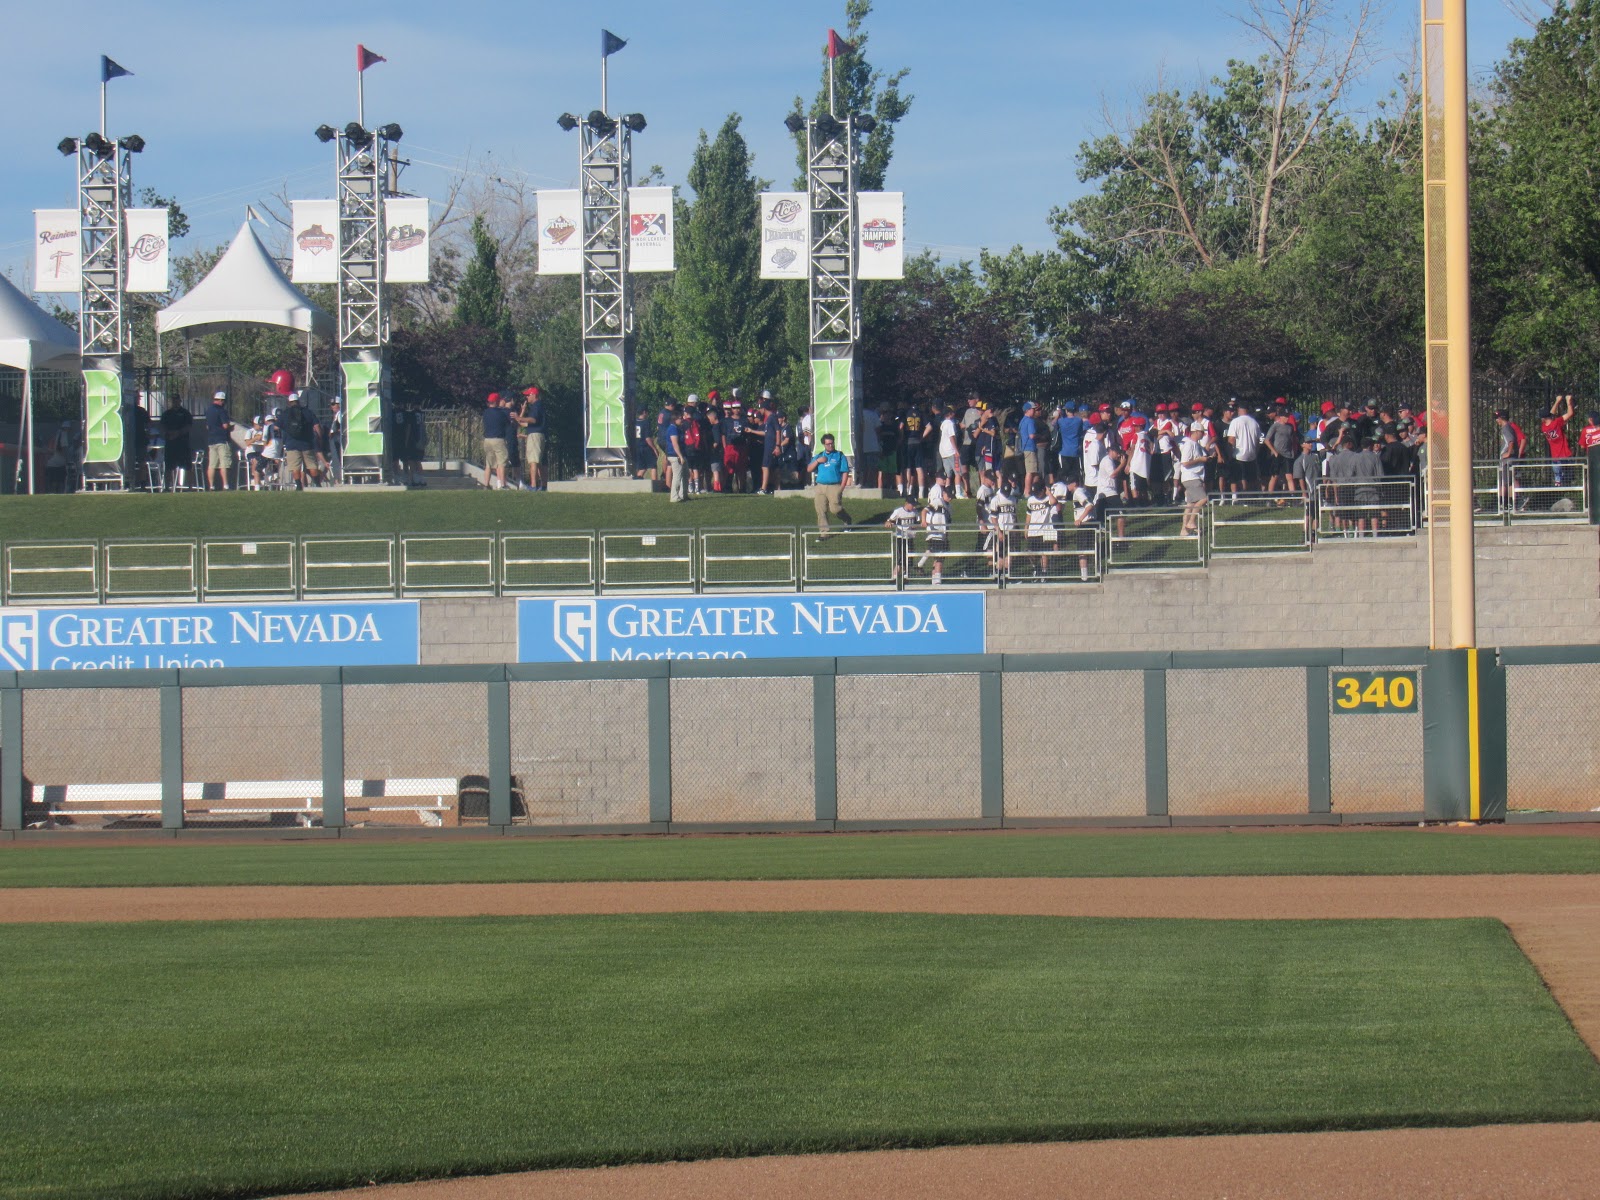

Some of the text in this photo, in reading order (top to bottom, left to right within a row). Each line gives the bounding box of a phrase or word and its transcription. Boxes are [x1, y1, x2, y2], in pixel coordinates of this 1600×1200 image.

[126, 238, 166, 258] Aces
[861, 231, 898, 241] CHAMPIONS
[49, 611, 382, 648] GREATER NEVADA
[607, 602, 947, 638] GREATER NEVADA
[1336, 677, 1414, 709] 340
